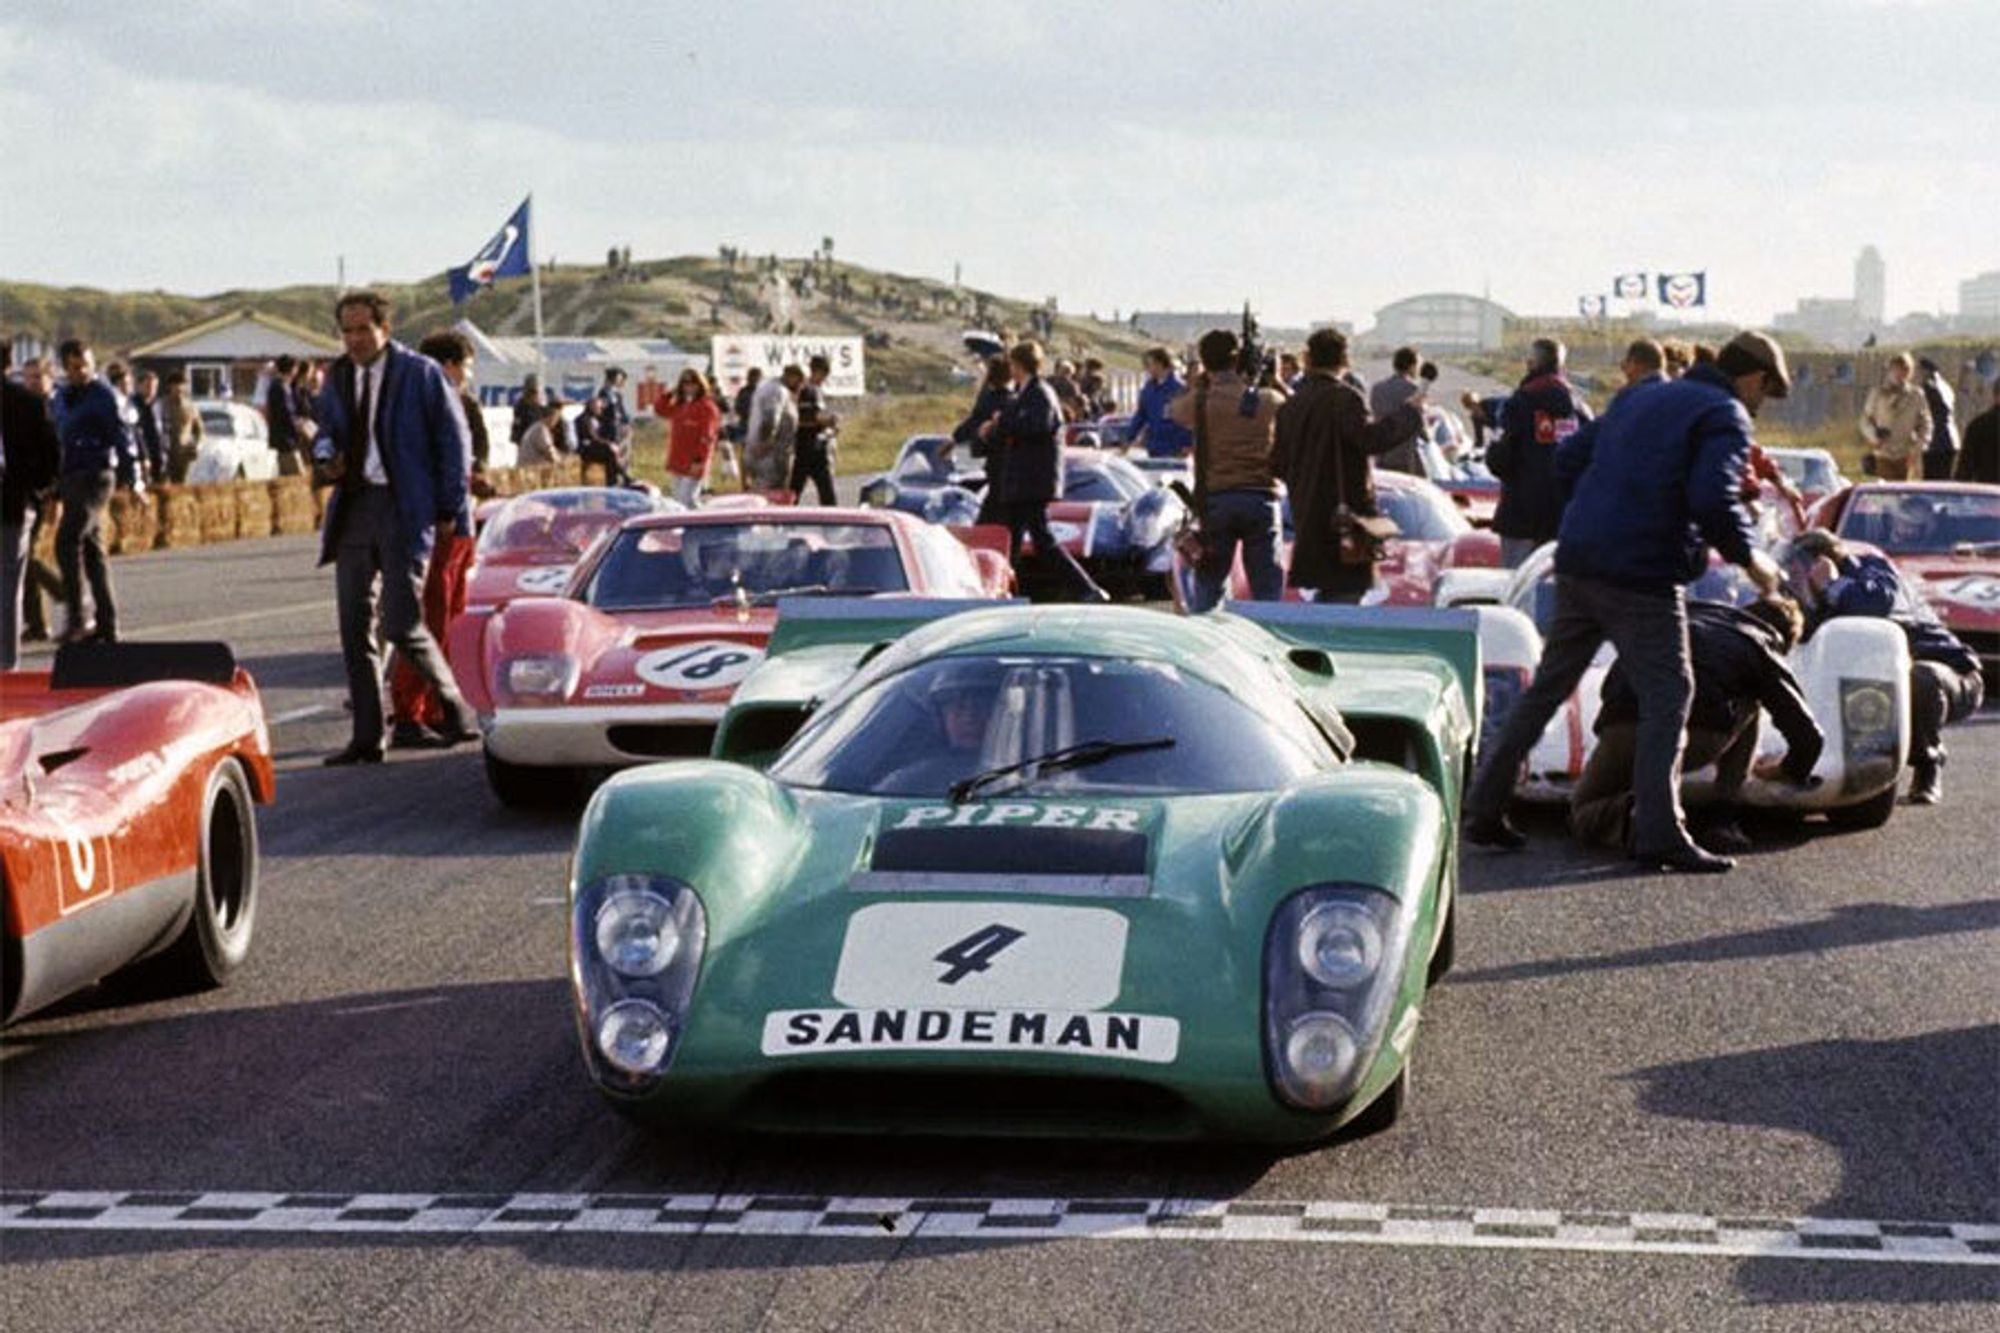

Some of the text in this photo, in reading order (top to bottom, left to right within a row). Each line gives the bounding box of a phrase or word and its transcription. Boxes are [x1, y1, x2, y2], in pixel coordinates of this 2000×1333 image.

[652, 645, 750, 679] 18
[894, 804, 1141, 831] PIPER
[933, 922, 1027, 985] 4
[786, 1009, 1142, 1052] SANDEMAN
